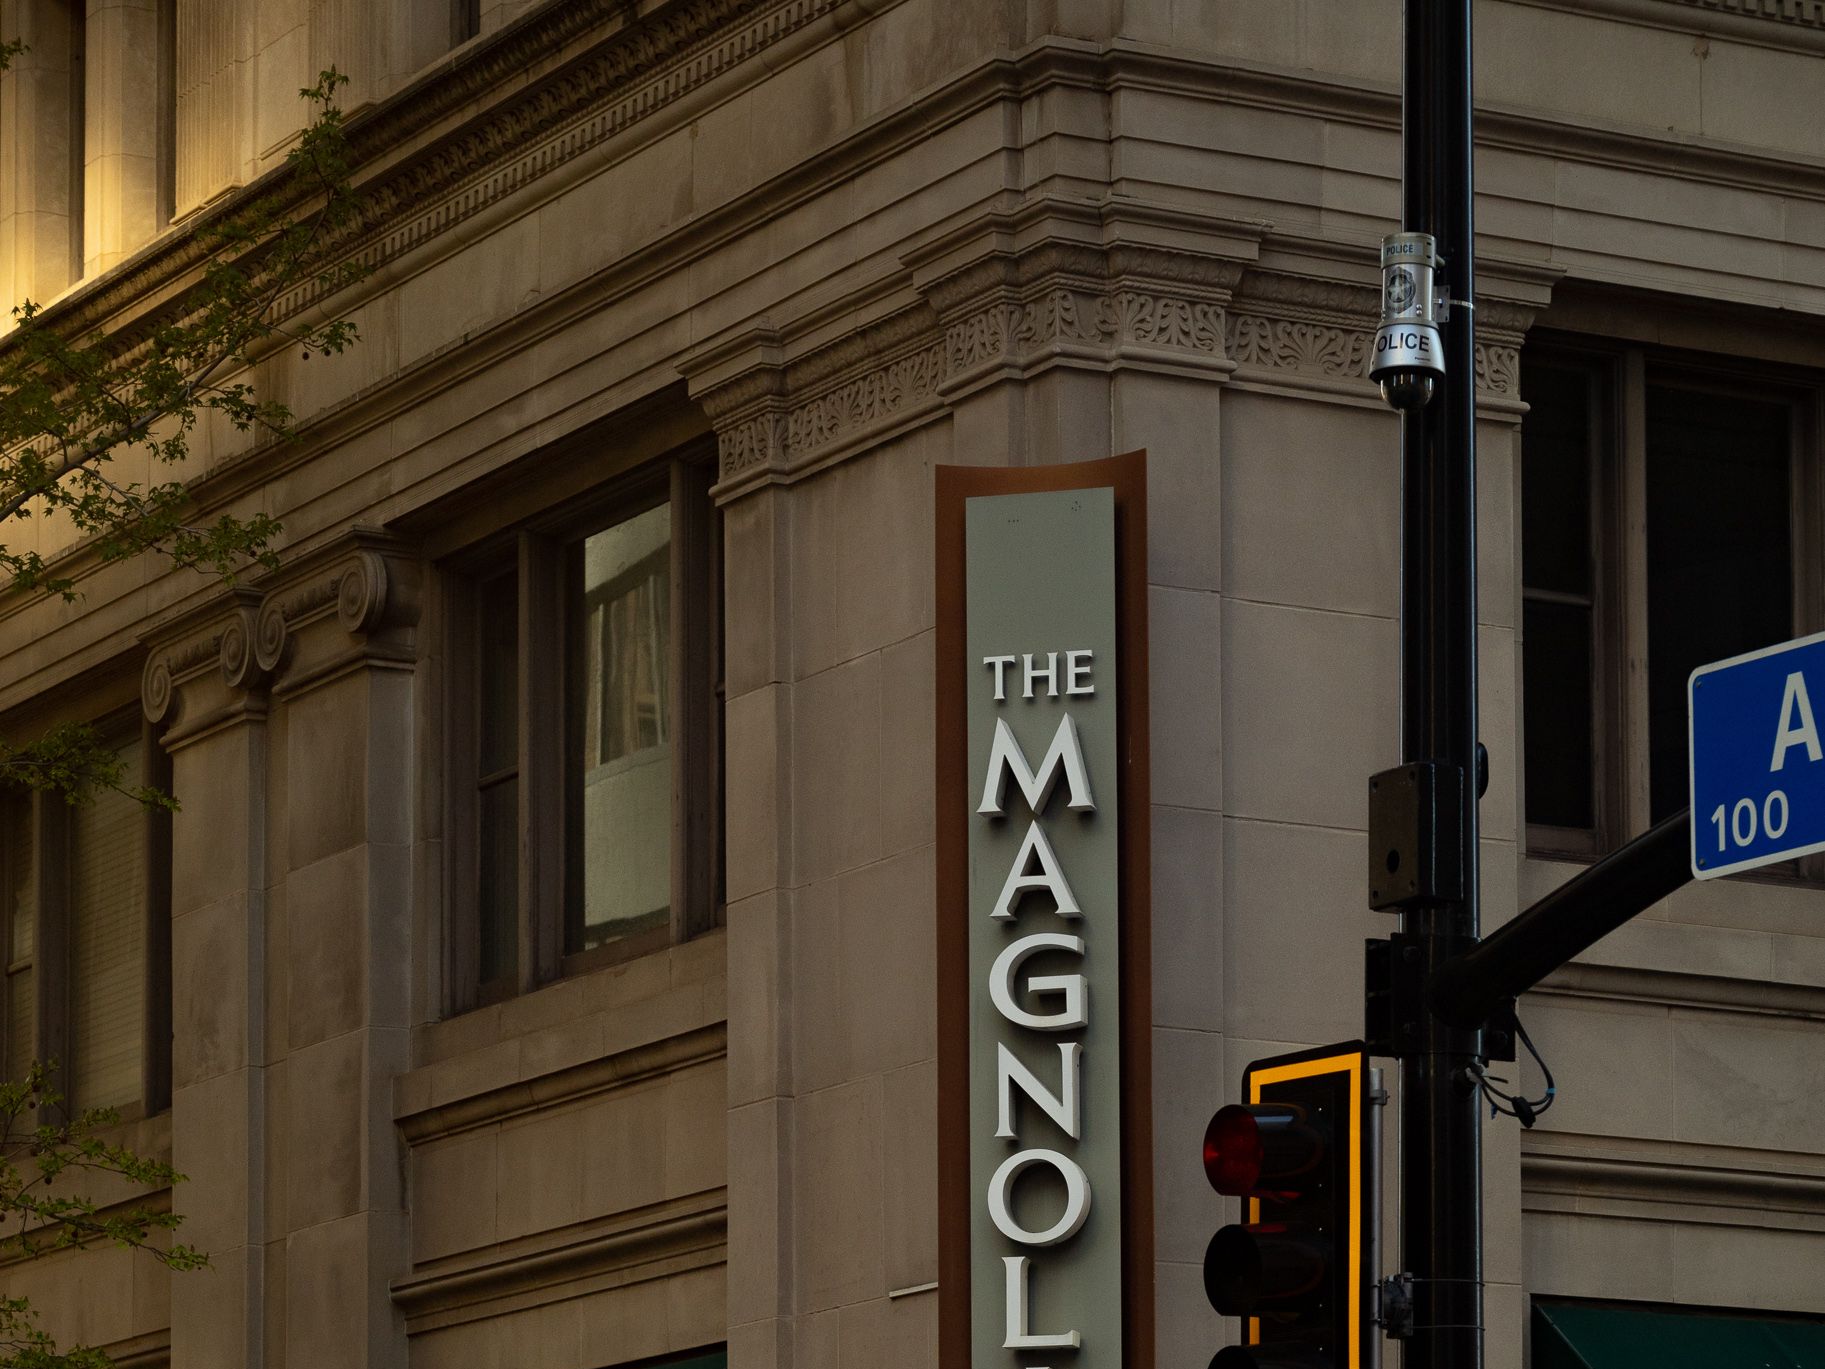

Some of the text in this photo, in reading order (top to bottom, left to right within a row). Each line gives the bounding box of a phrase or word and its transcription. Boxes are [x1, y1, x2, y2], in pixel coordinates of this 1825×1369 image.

[1386, 244, 1414, 256] POLICE
[1377, 332, 1430, 352] OLICE
[983, 649, 1095, 700] THE
[1710, 789, 1790, 853] 100
